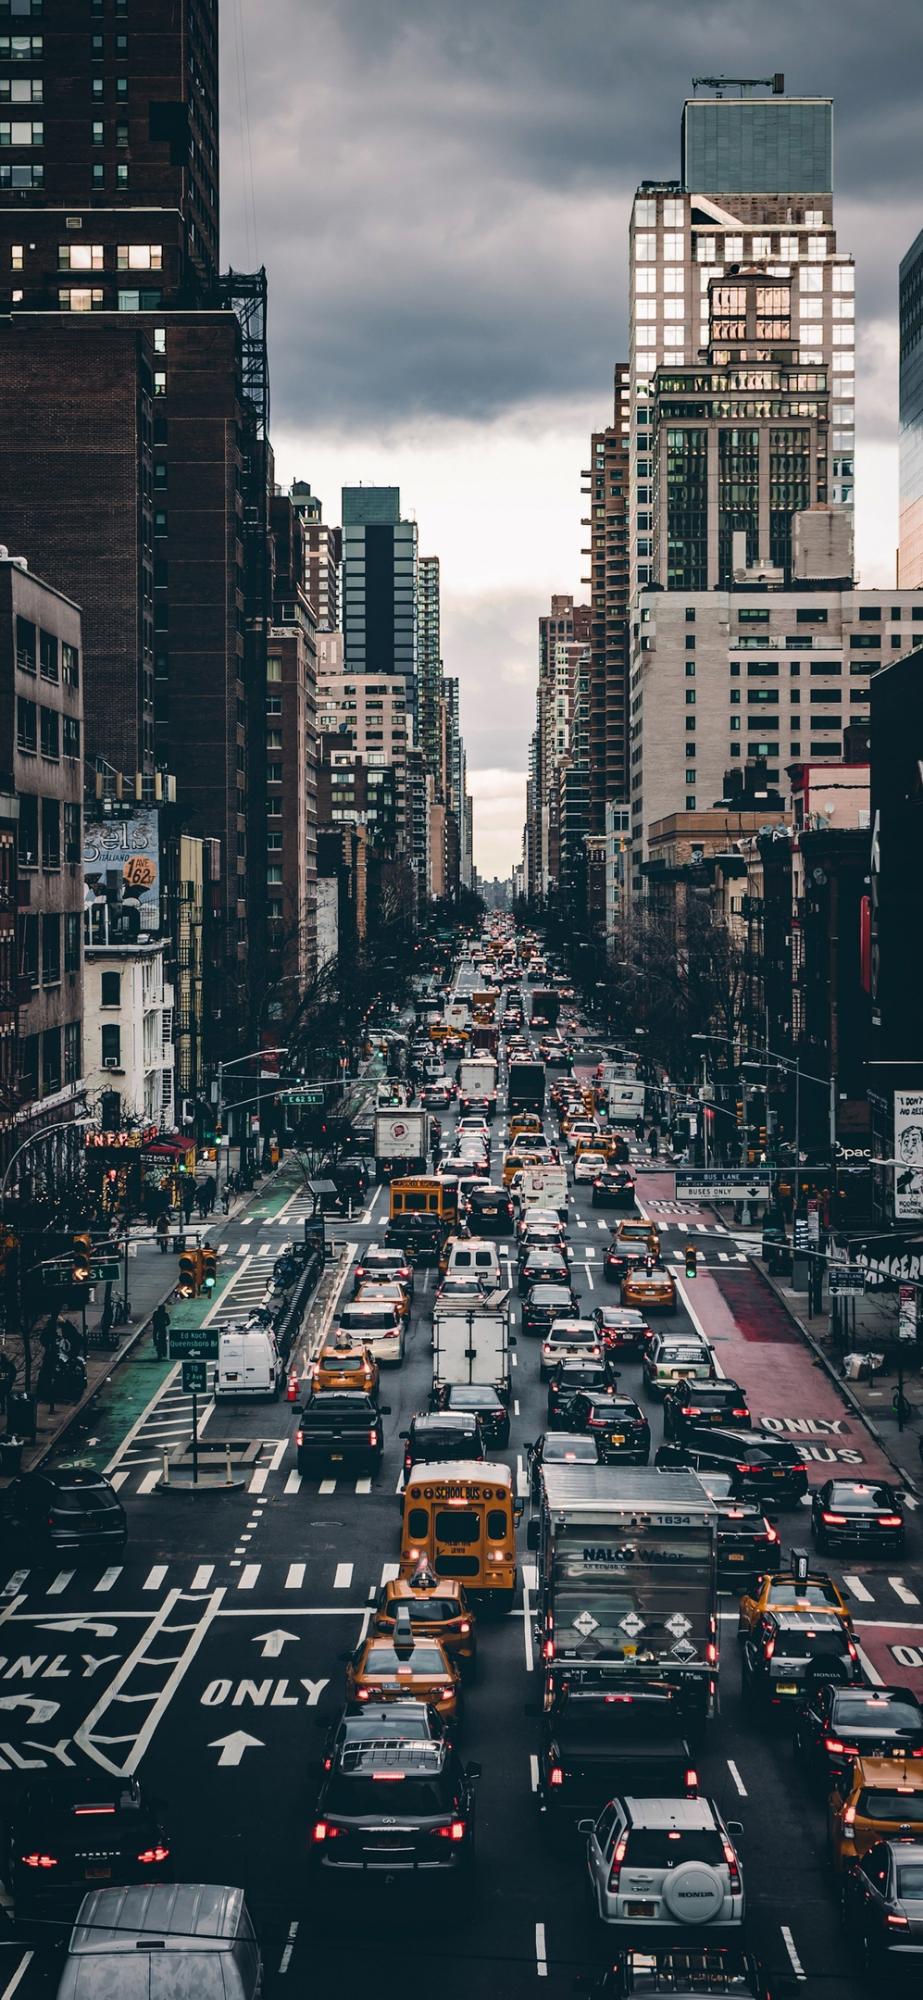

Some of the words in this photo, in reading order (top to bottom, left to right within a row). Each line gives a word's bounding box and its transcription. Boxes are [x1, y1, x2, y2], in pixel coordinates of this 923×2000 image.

[136, 859, 149, 867] AVE
[133, 869, 150, 883] 62
[170, 1340, 209, 1348] Queensboro
[760, 1417, 843, 1434] ONLY
[434, 1487, 464, 1499] SCHOOL
[465, 1487, 480, 1499] BUS
[583, 1548, 635, 1561] NALCO
[638, 1550, 684, 1561] Water
[200, 1679, 330, 1706] ONLY
